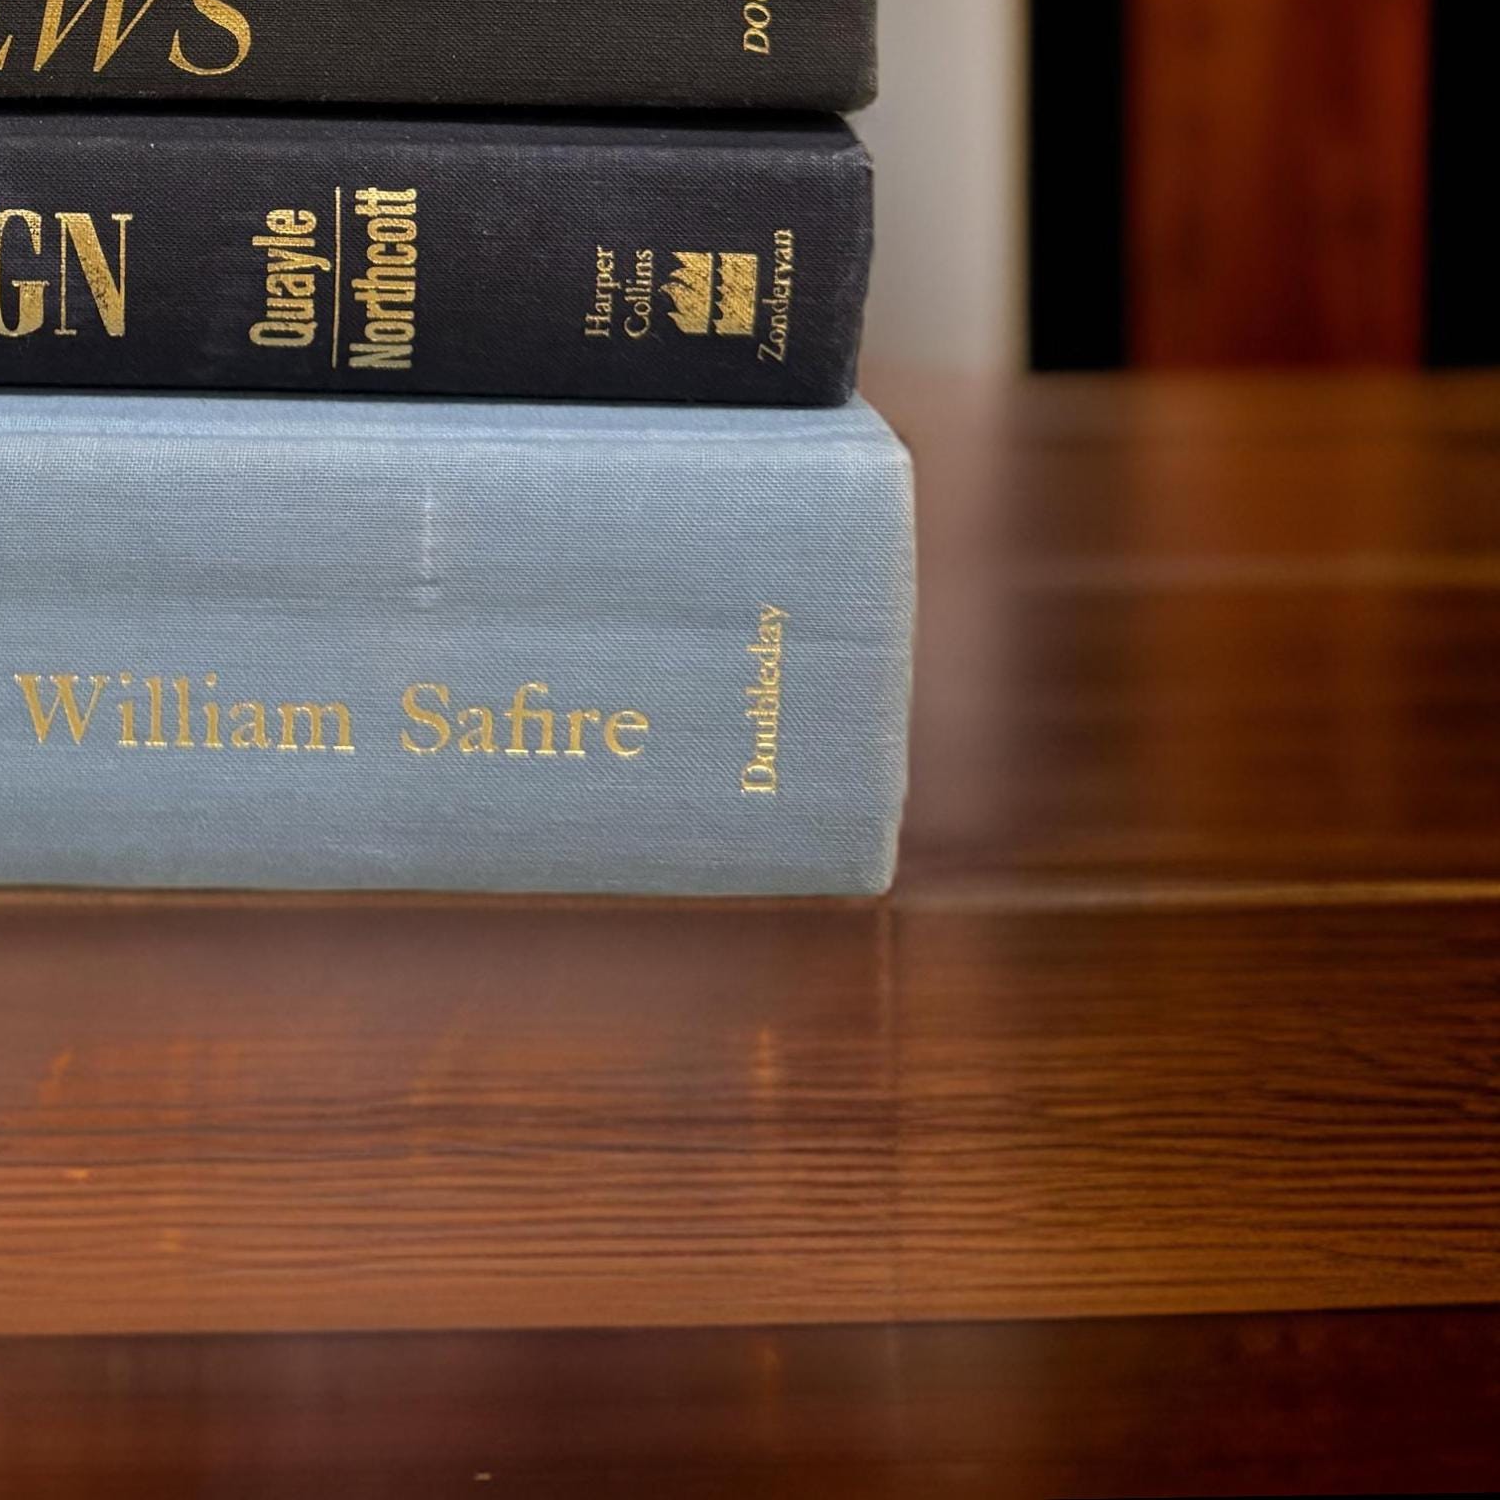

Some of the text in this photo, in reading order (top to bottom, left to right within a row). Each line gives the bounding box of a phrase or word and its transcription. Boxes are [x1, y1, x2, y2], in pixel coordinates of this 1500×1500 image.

[249, 208, 332, 348] Quayle
[347, 186, 418, 370] Northcott
[584, 244, 622, 339] Harper
[623, 248, 655, 340] Collins
[756, 228, 795, 364] Zondervan
[13, 671, 650, 757] William Safire
[741, 602, 792, 794] Doubleday
